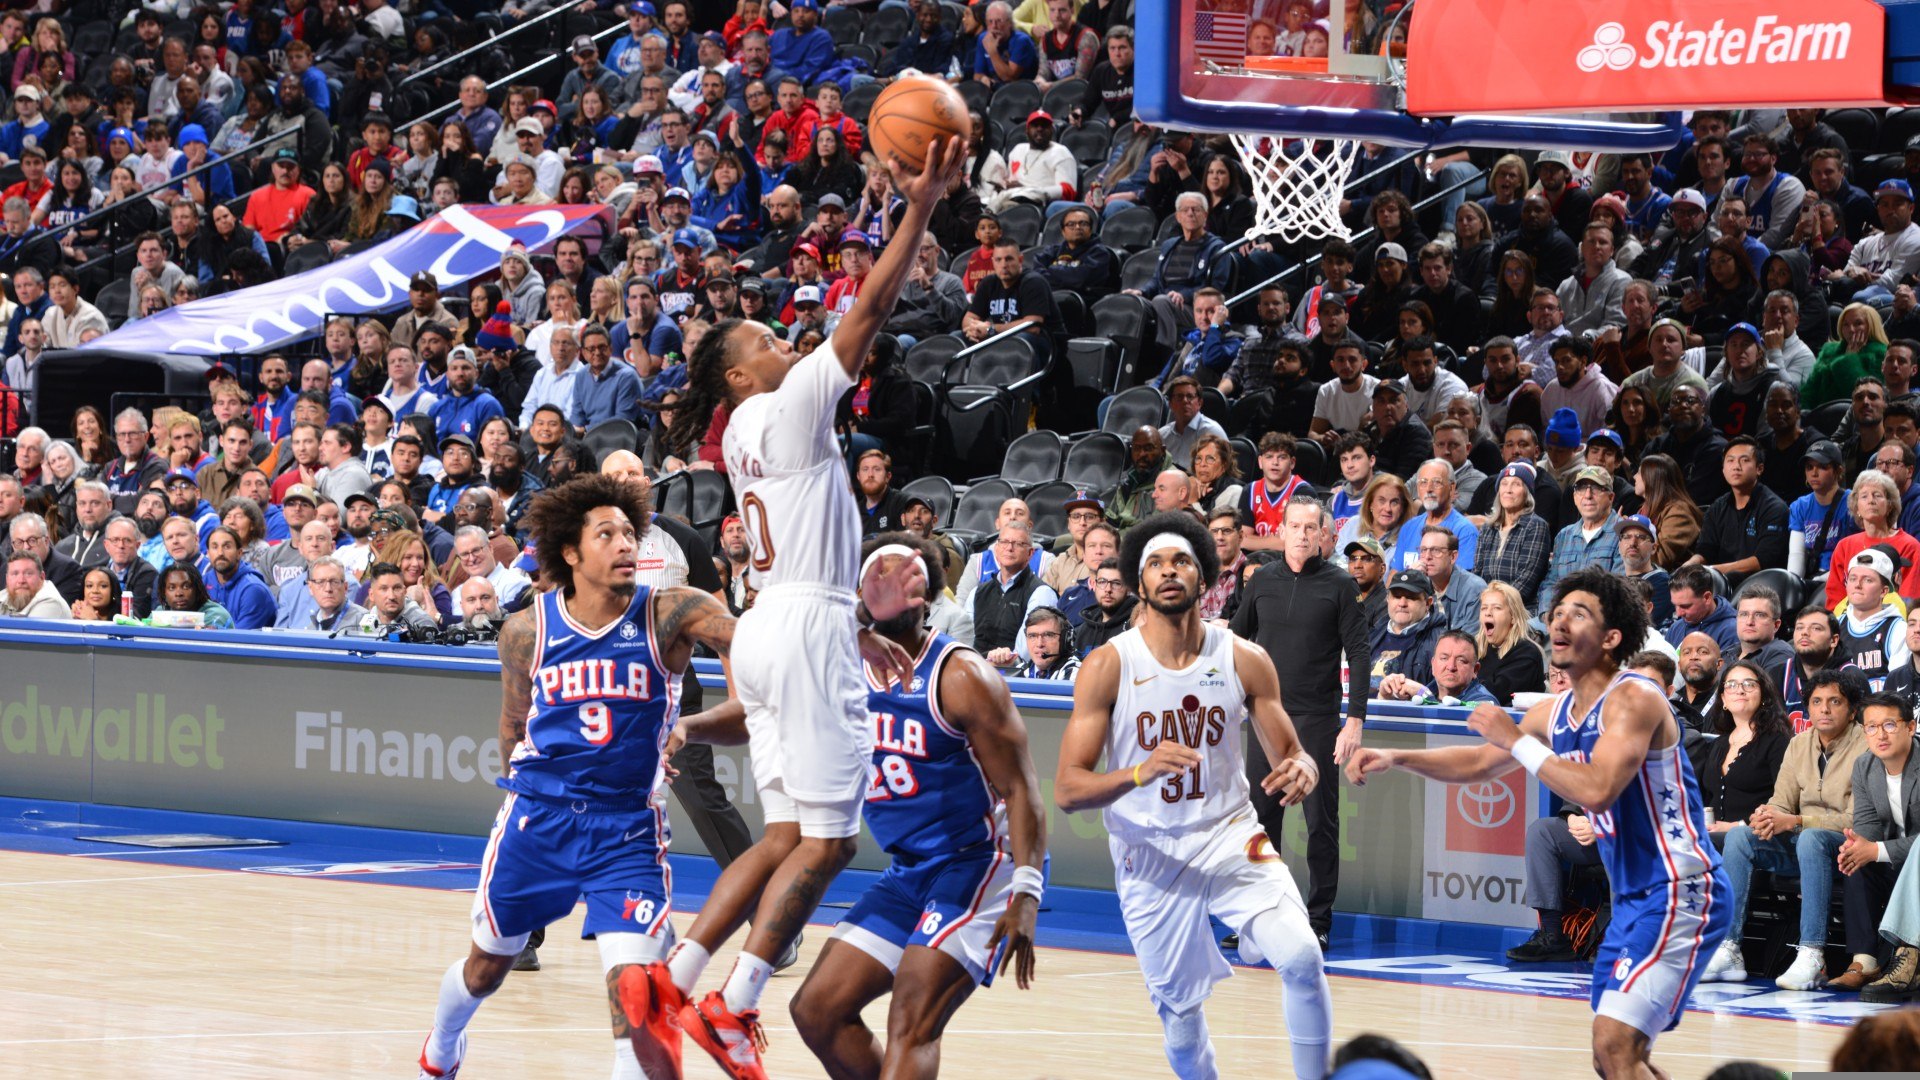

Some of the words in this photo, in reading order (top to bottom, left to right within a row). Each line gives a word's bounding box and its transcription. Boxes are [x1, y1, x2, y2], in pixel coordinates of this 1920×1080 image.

[539, 658, 652, 702] PHILA
[0, 685, 225, 770] dwallet
[580, 701, 613, 745] 9
[868, 711, 929, 758] ILA
[1135, 705, 1226, 751] CAVS
[1161, 760, 1205, 803] 31
[1426, 871, 1526, 904] TOYOT
[622, 898, 656, 924] 76
